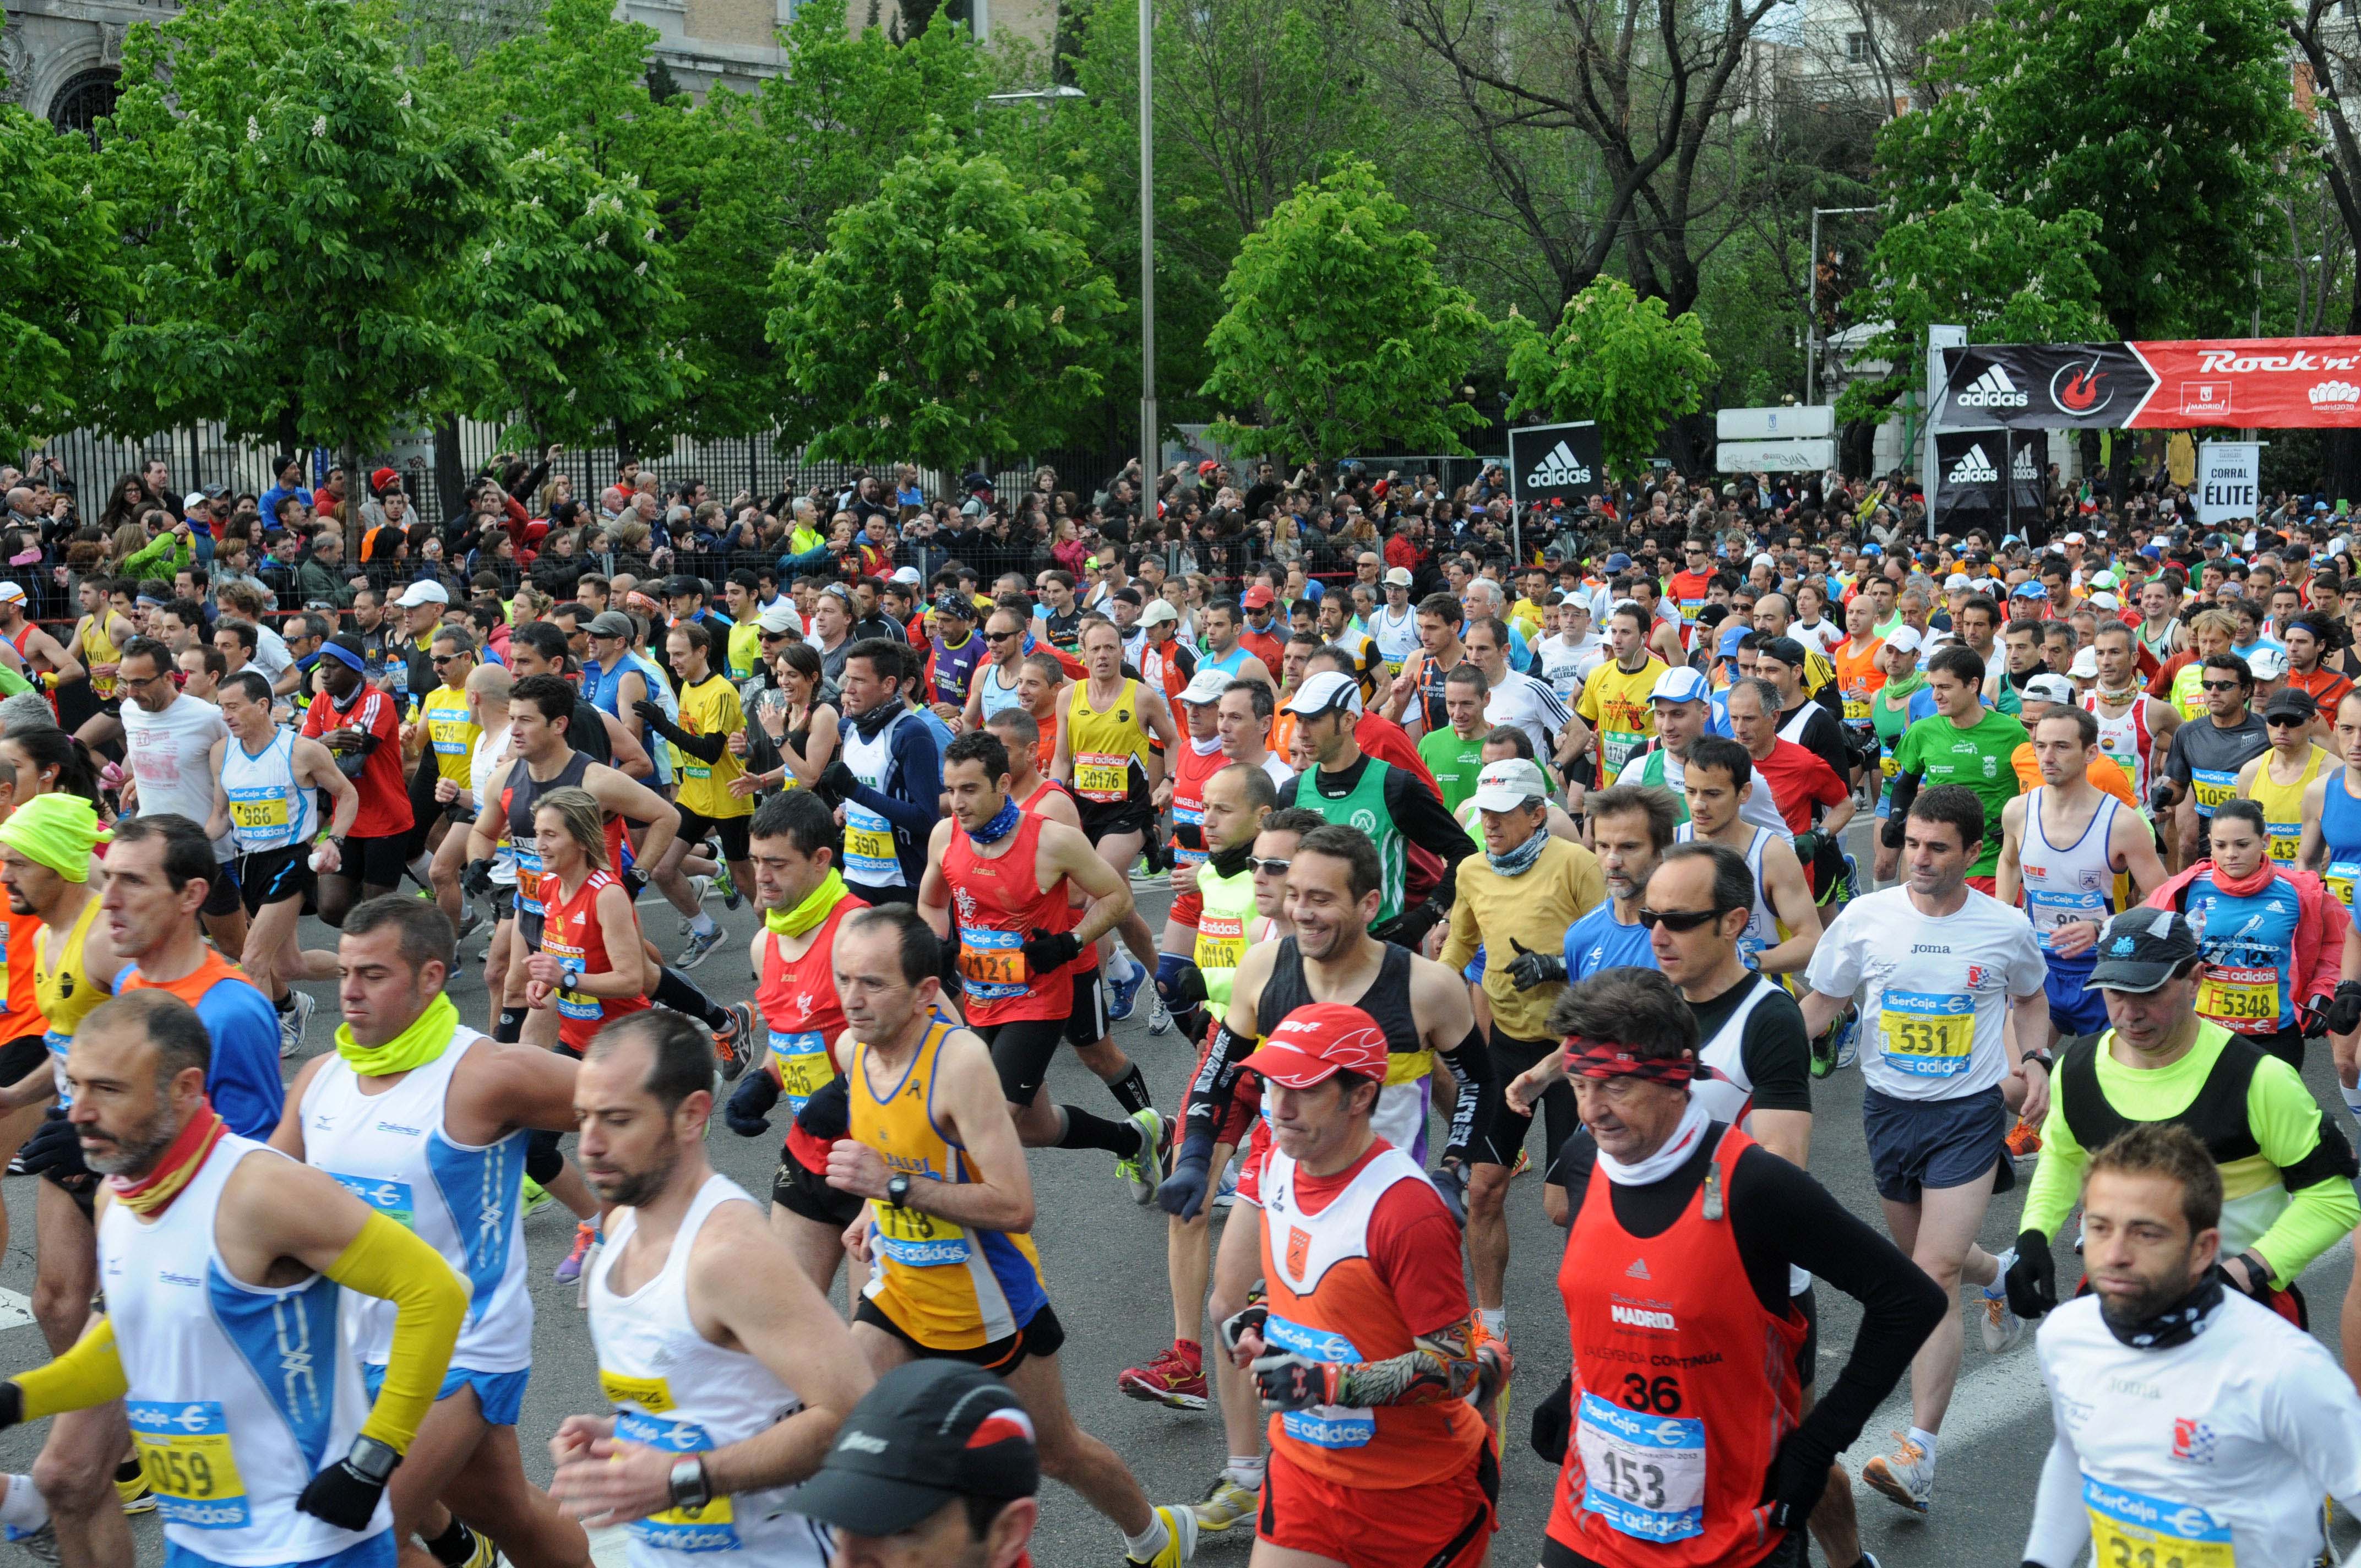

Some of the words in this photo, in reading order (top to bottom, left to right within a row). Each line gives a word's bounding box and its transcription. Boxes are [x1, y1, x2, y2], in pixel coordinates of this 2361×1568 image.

[2197, 350, 2319, 373] Rock
[1957, 390, 2028, 406] adidas
[1527, 467, 1591, 488] adidas
[1949, 468, 1998, 483] adidas
[2211, 468, 2248, 478] CORRAL
[2205, 481, 2254, 505] ÉLITE
[435, 725, 455, 742] 674
[1095, 756, 1125, 765] adidas
[1083, 770, 1119, 789] 20176
[243, 807, 272, 825] 986
[253, 827, 286, 837] adidas
[853, 835, 880, 858] 390
[862, 860, 896, 869] adidas
[2230, 970, 2276, 982] adidas
[1900, 1023, 1948, 1055] 531
[904, 1244, 963, 1262] adidas
[1611, 1305, 1675, 1329] MADRID
[1623, 1373, 1682, 1415] 36
[1300, 1422, 1372, 1442] adidas
[1602, 1450, 1665, 1510] 153
[1622, 1510, 1694, 1537] adidas
